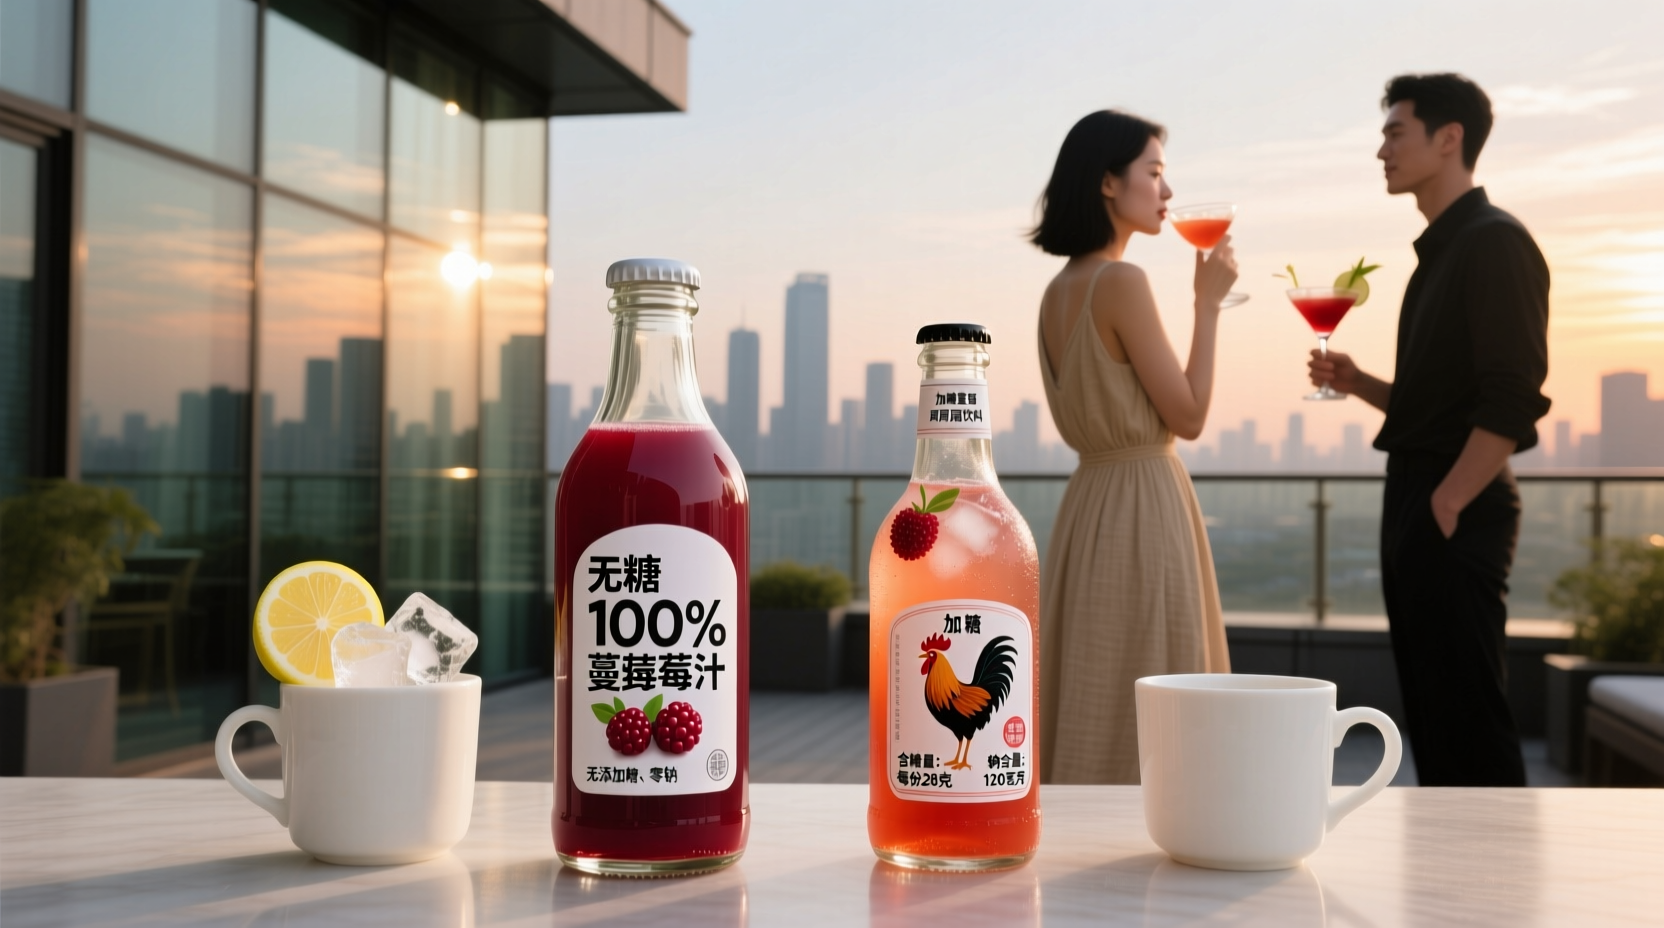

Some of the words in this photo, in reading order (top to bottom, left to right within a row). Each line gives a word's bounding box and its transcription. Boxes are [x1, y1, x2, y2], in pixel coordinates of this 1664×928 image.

[588, 554, 661, 593] 无糖
[588, 599, 726, 648] 100%
[943, 613, 981, 634] 加糖
